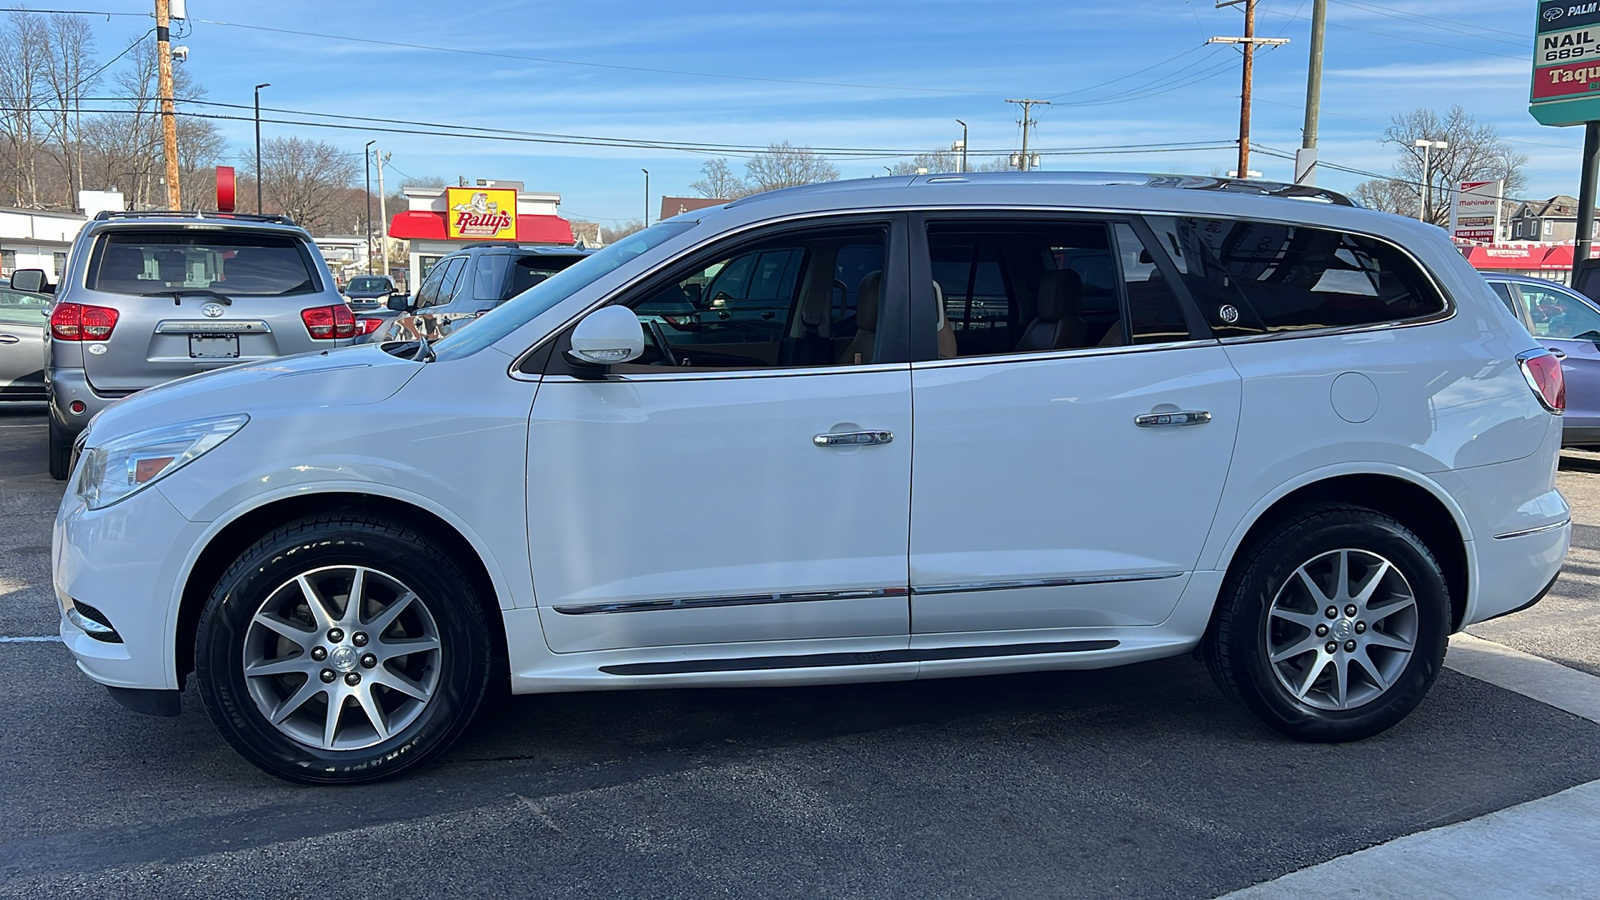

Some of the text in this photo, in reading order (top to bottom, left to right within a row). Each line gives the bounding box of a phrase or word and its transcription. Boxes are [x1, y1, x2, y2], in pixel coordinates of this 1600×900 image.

[1567, 2, 1597, 17] PALM
[1544, 31, 1595, 50] NAIL
[1459, 199, 1495, 207] Mahindra
[455, 210, 512, 235] Rally's
[180, 323, 247, 331] SEQUOIA
